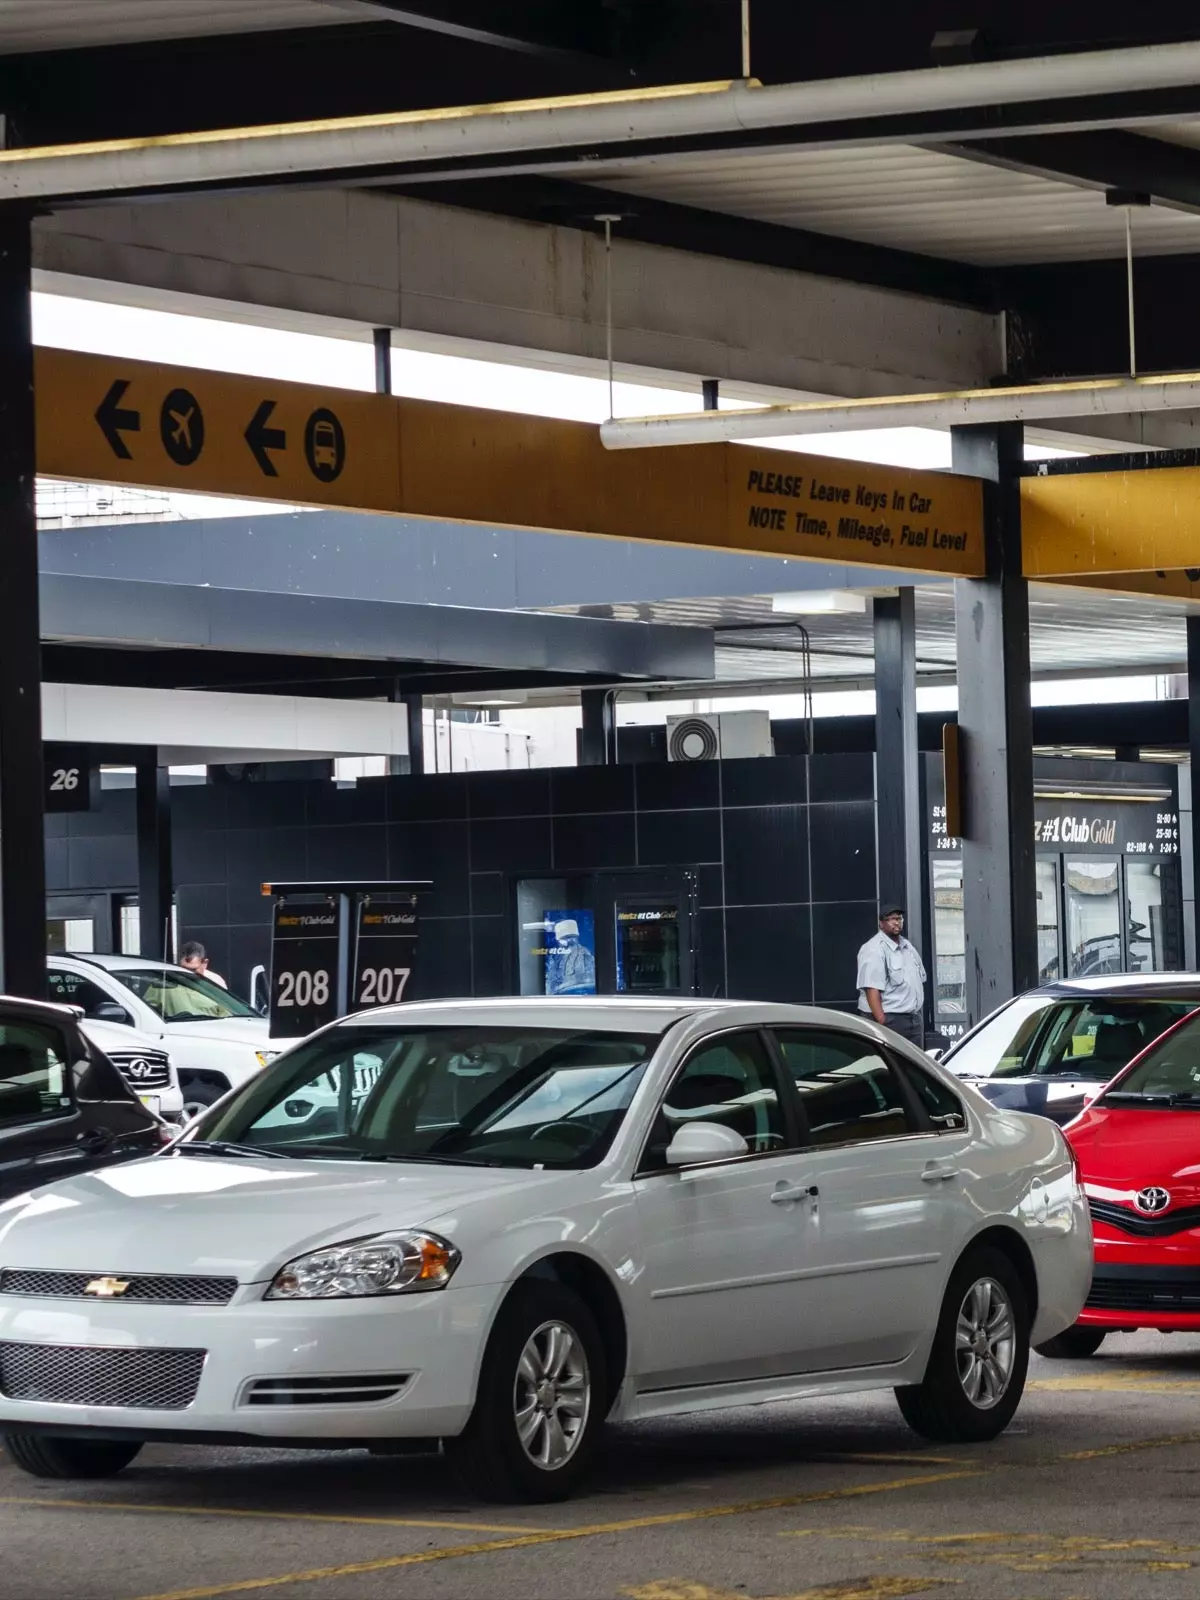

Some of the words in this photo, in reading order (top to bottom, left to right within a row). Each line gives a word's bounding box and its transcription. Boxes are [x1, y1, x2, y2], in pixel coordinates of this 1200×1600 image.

[748, 470, 803, 498] PLEASE
[810, 479, 850, 504] Leave
[856, 484, 887, 512] Keys
[893, 491, 905, 512] In
[910, 492, 932, 514] Car
[748, 506, 787, 531] NOTE
[796, 512, 831, 540] Time,
[837, 518, 894, 547] Mileage,
[900, 525, 928, 547] Fuel
[933, 530, 968, 551] Level
[50, 768, 80, 790] 26
[933, 806, 946, 817] 51-8
[932, 822, 947, 833] 25-5
[1042, 816, 1060, 842] #1
[1160, 842, 1172, 853] 1-24
[618, 912, 638, 920] Hertz
[557, 947, 572, 955] Club
[277, 970, 329, 1007] 208
[360, 967, 411, 1003] 207
